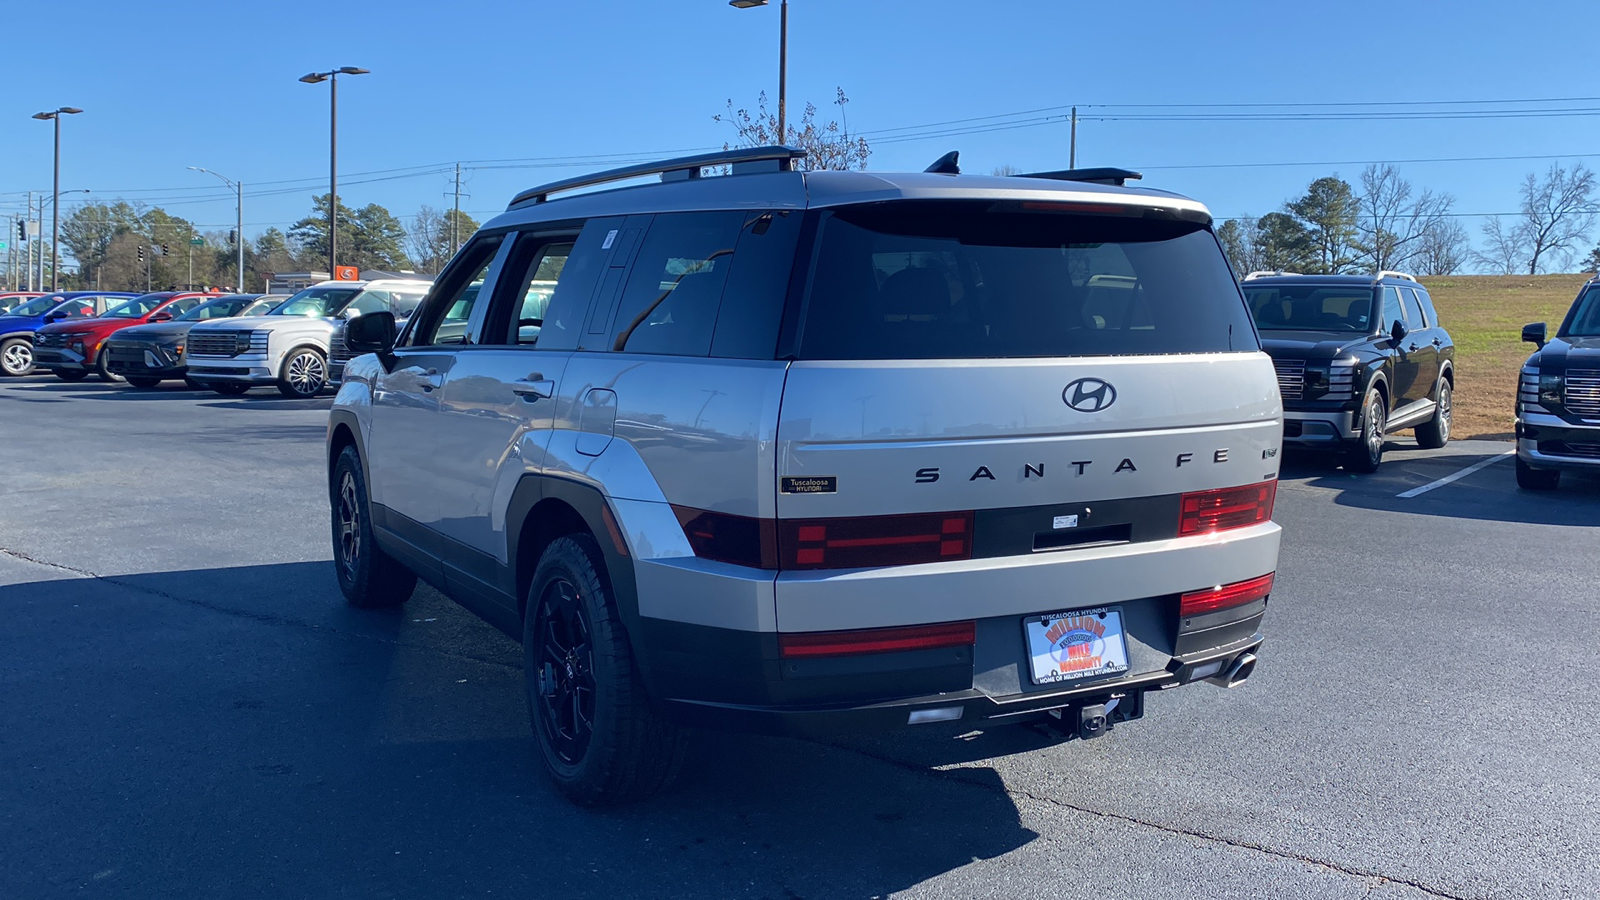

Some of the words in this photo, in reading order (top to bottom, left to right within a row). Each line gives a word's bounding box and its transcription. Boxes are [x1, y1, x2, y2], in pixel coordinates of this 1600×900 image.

[915, 457, 1138, 483] SANTA
[1176, 448, 1230, 469] FE
[1041, 611, 1080, 621] TUSCALOOSA
[1081, 607, 1108, 616] HYUNDAI
[1045, 616, 1106, 645] MILLION
[1067, 642, 1091, 658] MILE
[1059, 656, 1102, 673] WARRANTY
[1039, 676, 1055, 684] HOME
[1063, 672, 1083, 681] MILLION
[1083, 669, 1095, 677] MILE
